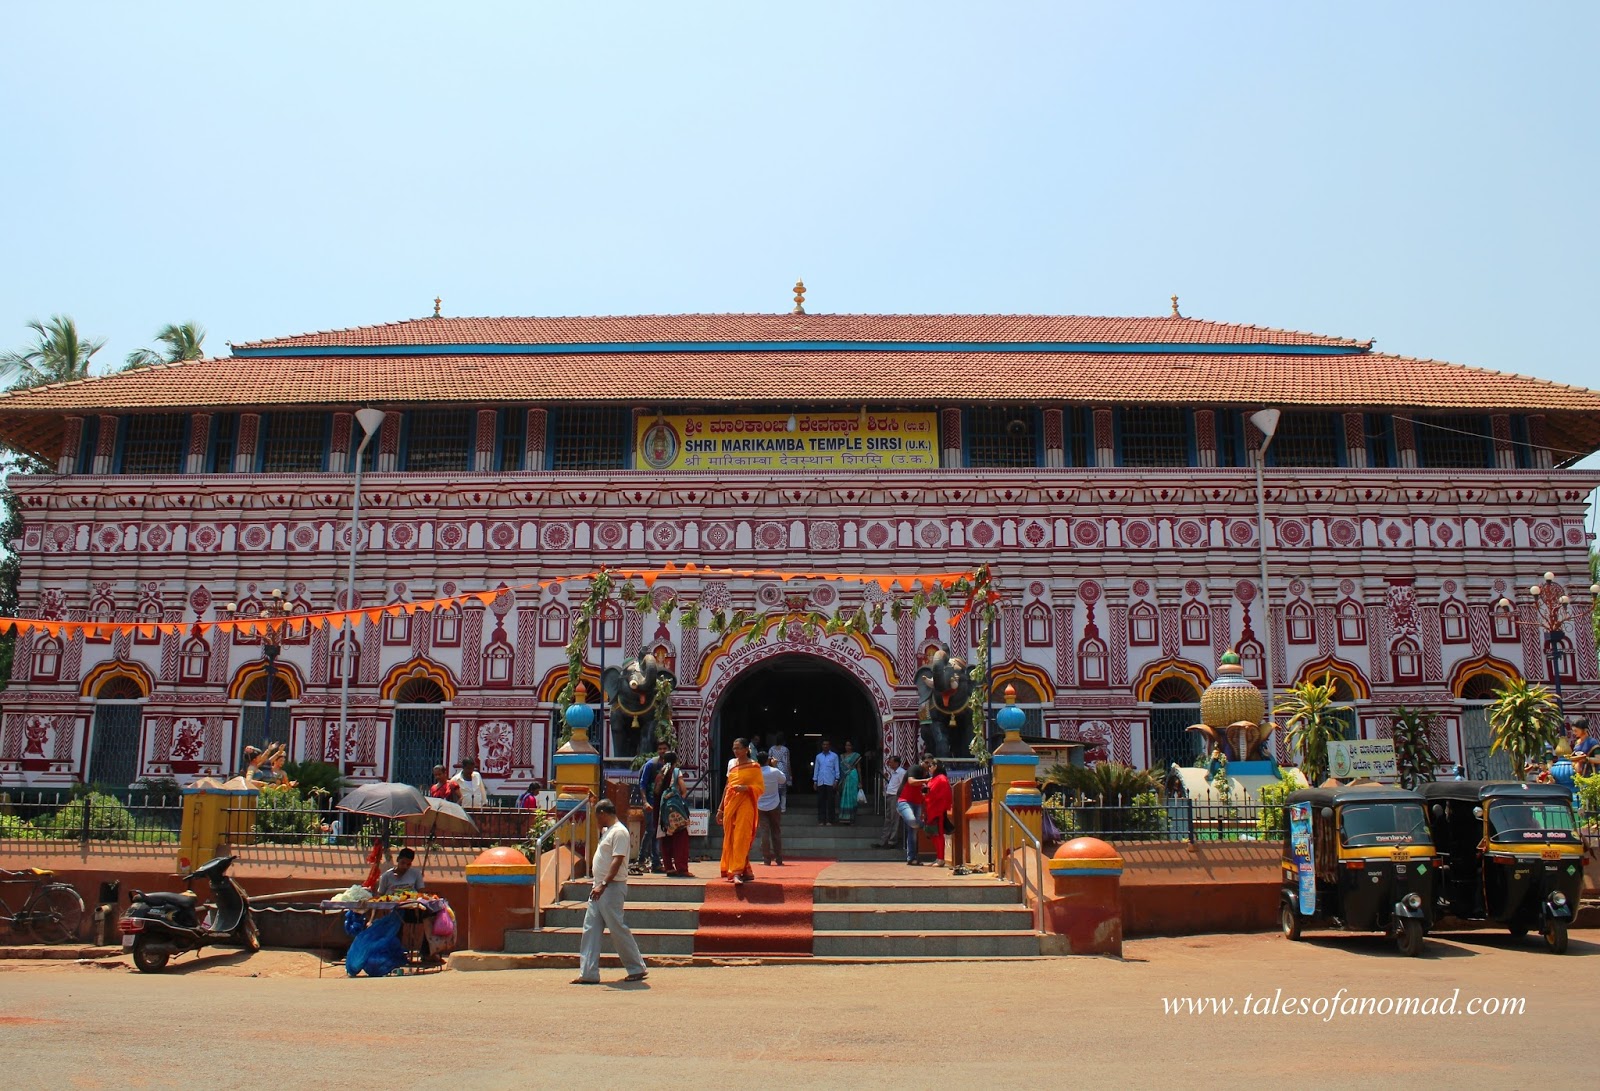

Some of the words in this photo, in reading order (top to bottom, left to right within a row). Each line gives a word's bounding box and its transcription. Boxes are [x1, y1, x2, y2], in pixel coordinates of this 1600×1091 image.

[684, 417, 703, 436] ಶ್ರೀ
[799, 415, 859, 437] ದೇವಸ್ಥಾನ
[867, 415, 899, 431] ಶಿರಸಿ
[685, 439, 717, 452] SHRI
[721, 438, 805, 452] MARIKAMBA
[808, 437, 862, 451] TEMPLE
[866, 437, 902, 450] SIRSI
[905, 439, 931, 452] (U.K.)
[684, 454, 702, 466] श्री
[708, 453, 773, 466] मारिकाम्बा
[779, 452, 835, 465] देवस्थान
[841, 452, 883, 465] शिरसि
